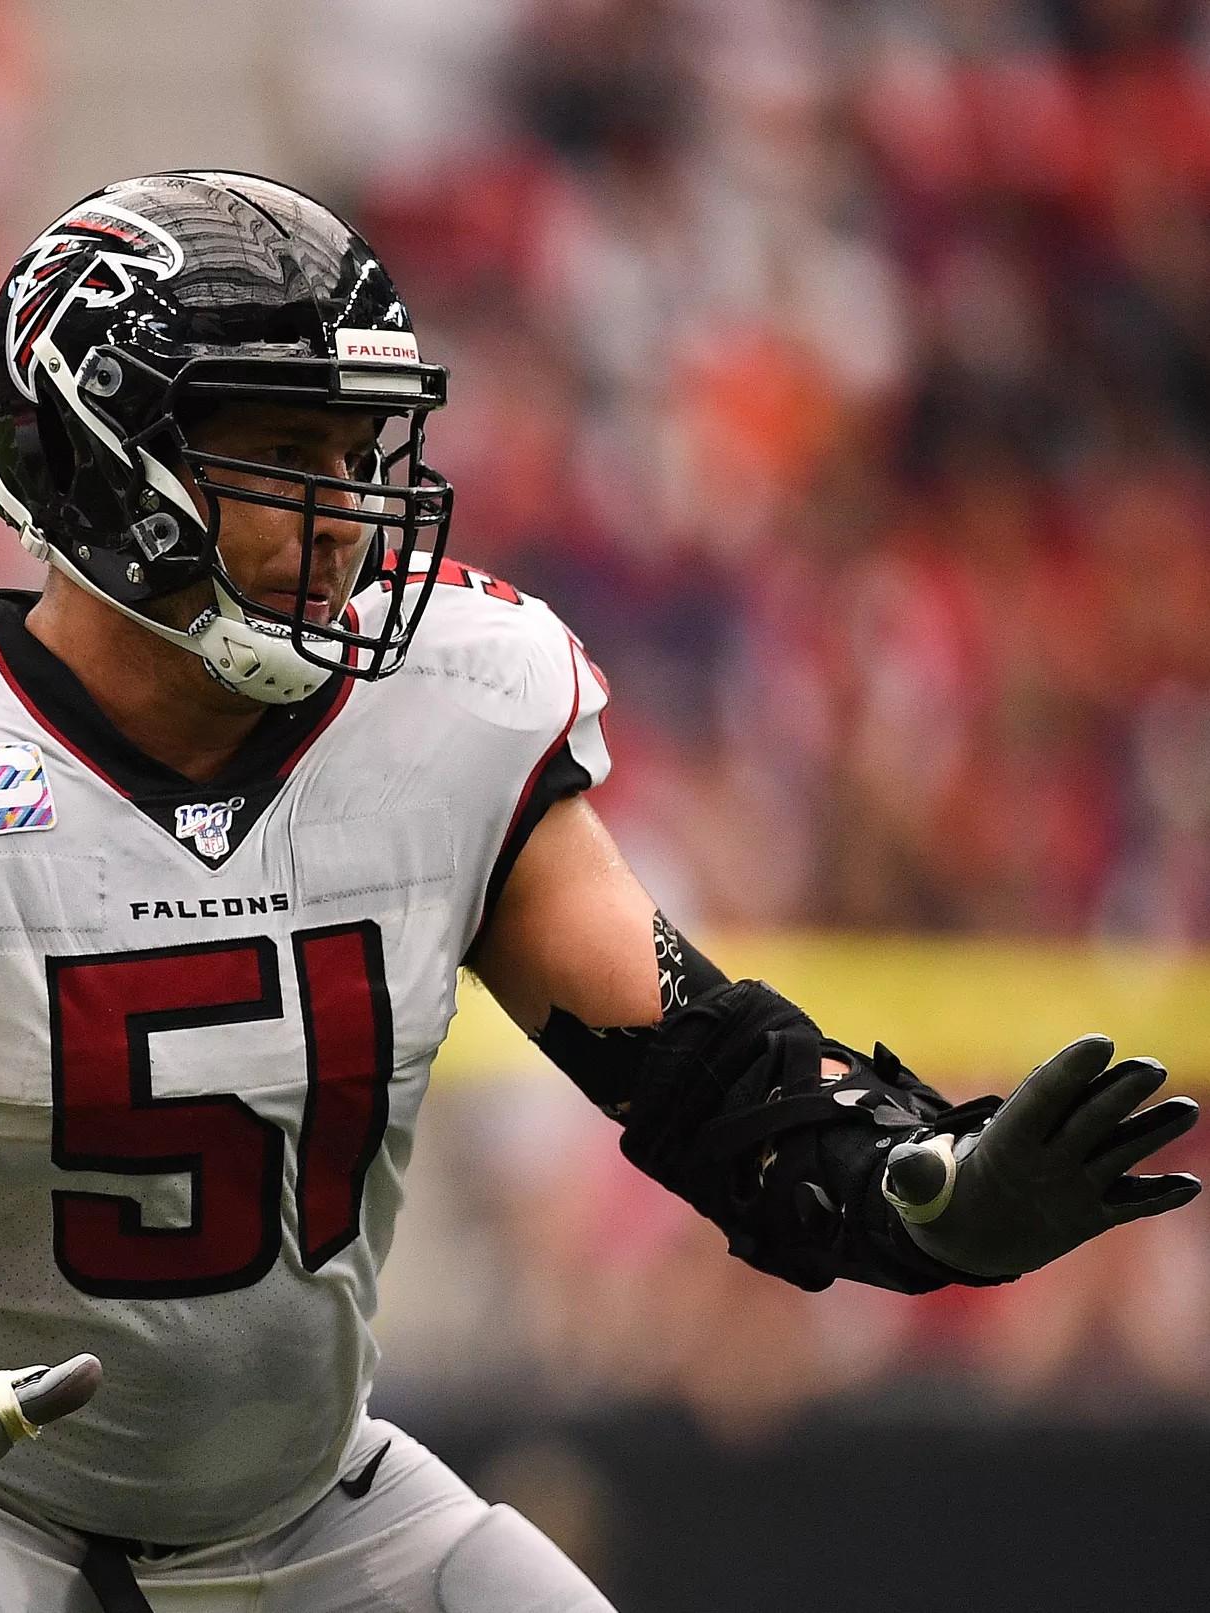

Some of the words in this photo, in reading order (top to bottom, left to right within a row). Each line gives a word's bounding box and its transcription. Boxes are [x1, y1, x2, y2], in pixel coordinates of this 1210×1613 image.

[347, 344, 417, 361] FALCONS
[204, 837, 224, 852] NFL
[130, 893, 290, 920] FALCONS
[45, 918, 393, 1300] 51
